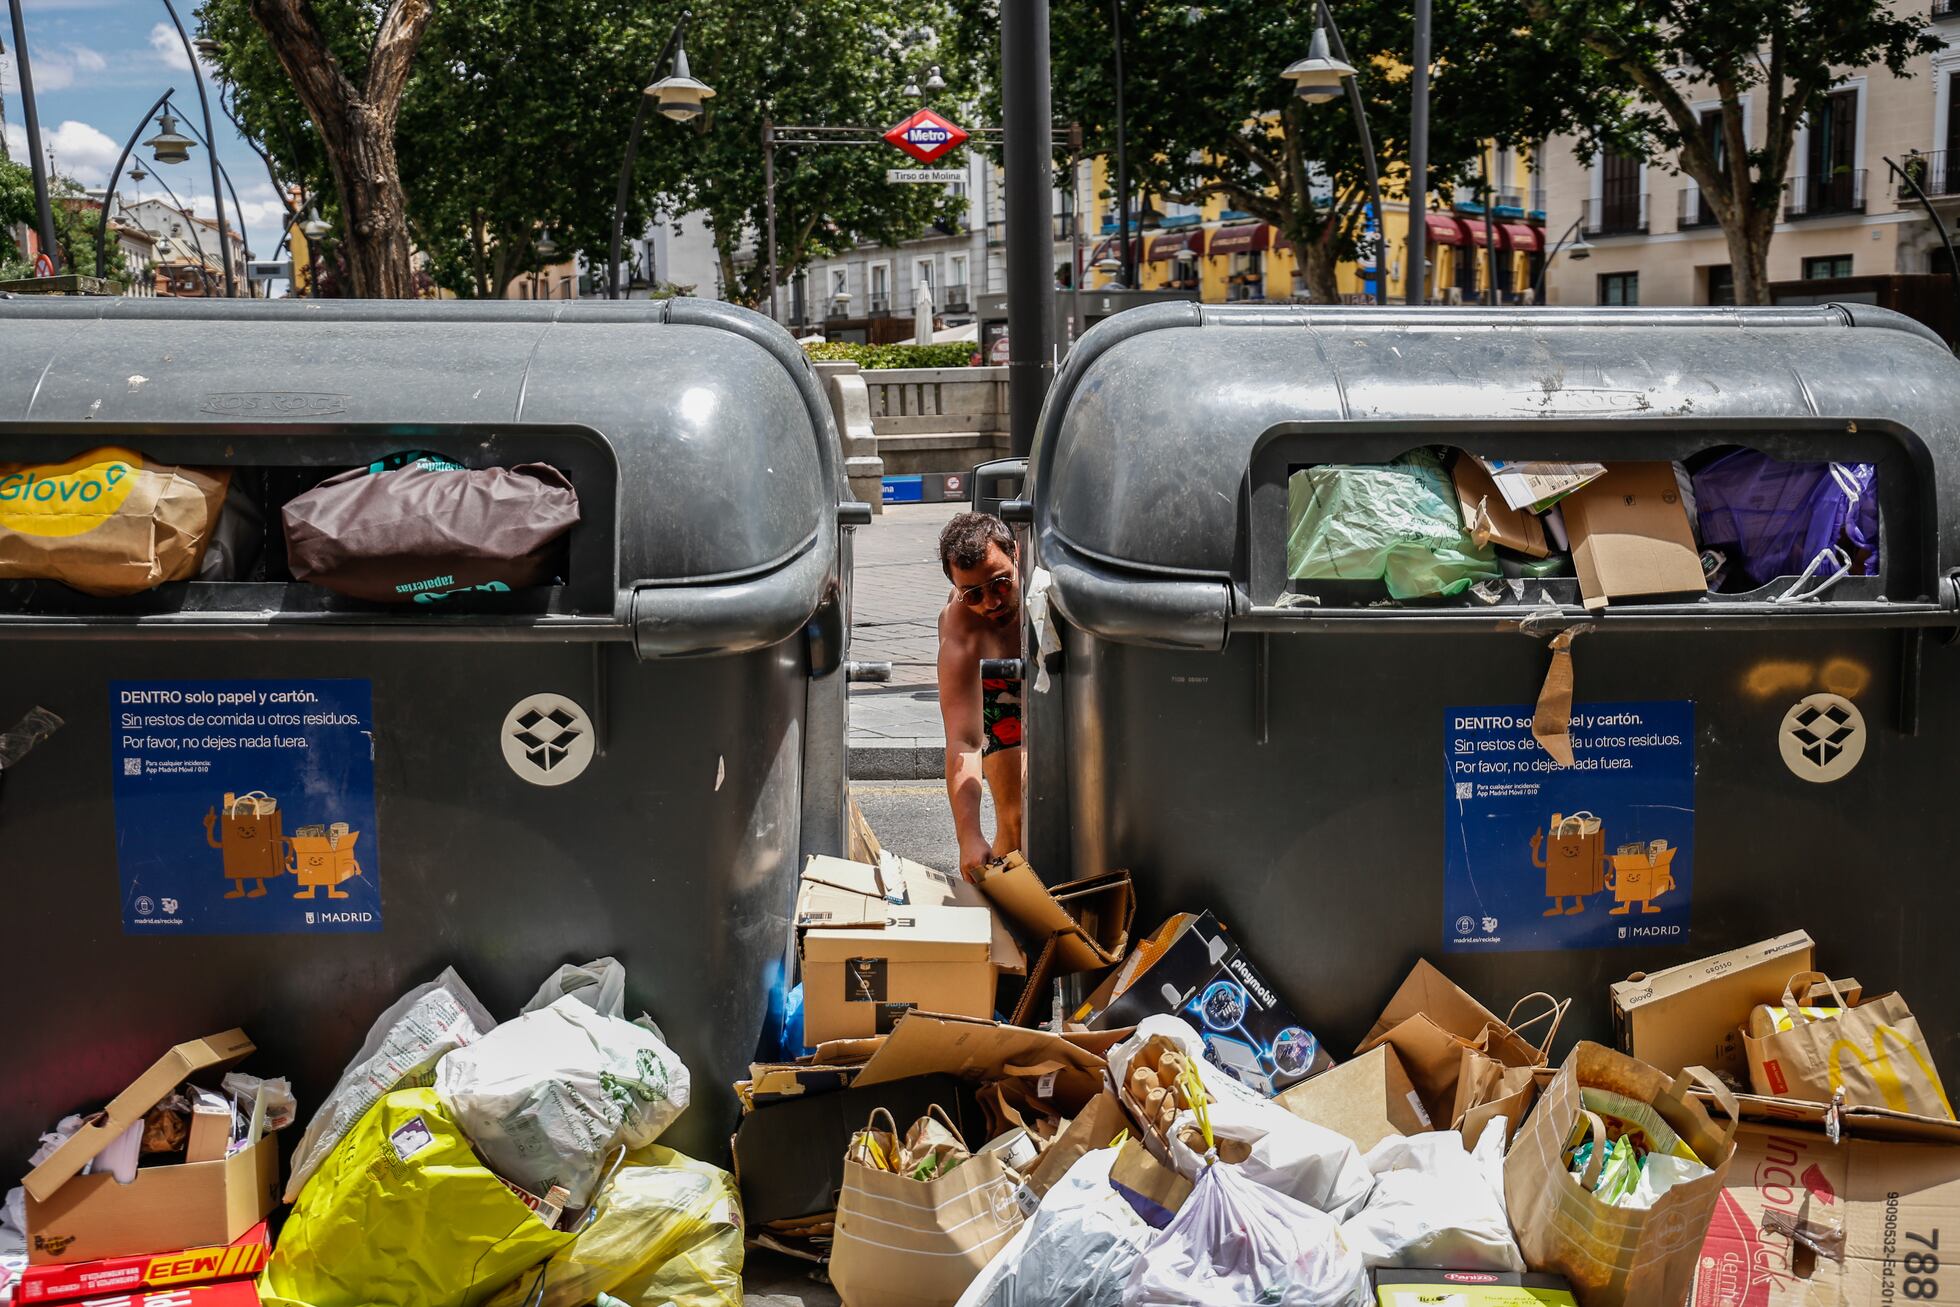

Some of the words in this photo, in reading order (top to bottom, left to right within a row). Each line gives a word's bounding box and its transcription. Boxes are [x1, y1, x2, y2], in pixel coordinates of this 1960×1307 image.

[910, 129, 945, 141] Metro
[895, 172, 917, 180] Tirso
[919, 172, 930, 180] de
[932, 172, 960, 180] Molina
[0, 472, 102, 502] Glovo
[121, 691, 182, 703] DENTRO
[185, 690, 214, 703] solo
[217, 690, 255, 706] papel
[259, 692, 267, 705] y
[270, 690, 318, 702] cartón.
[121, 713, 142, 727] Sin
[145, 713, 185, 726] restos
[187, 713, 204, 725] de
[207, 713, 255, 726] comida
[257, 715, 265, 725] u
[268, 714, 300, 725] otros
[303, 712, 360, 725] residuos.
[1454, 716, 1513, 730] DENTRO
[1587, 716, 1595, 728] y
[1597, 712, 1643, 726] cartón.
[123, 735, 144, 748] Por
[147, 735, 180, 750] favor,
[183, 739, 199, 748] no
[201, 735, 237, 750] dejes
[240, 735, 271, 748] nada
[273, 735, 309, 748] fuera.
[1454, 738, 1474, 753] Sin
[1477, 739, 1513, 751] restos
[1518, 737, 1535, 750] de
[1585, 738, 1592, 748] u
[1595, 736, 1625, 747] otros
[1628, 734, 1682, 747] residuos.
[158, 760, 183, 768] cualquier
[1455, 760, 1476, 773] Por
[1478, 760, 1510, 774] favor,
[1513, 762, 1529, 772] no
[1600, 757, 1633, 769] fuera.
[322, 912, 373, 922] MADRID
[1633, 926, 1681, 937] MADRID
[1705, 961, 1733, 975] GROSSO
[1230, 958, 1278, 1009] playmobil
[1629, 988, 1653, 1004] Glovo
[1903, 1228, 1940, 1299] 788
